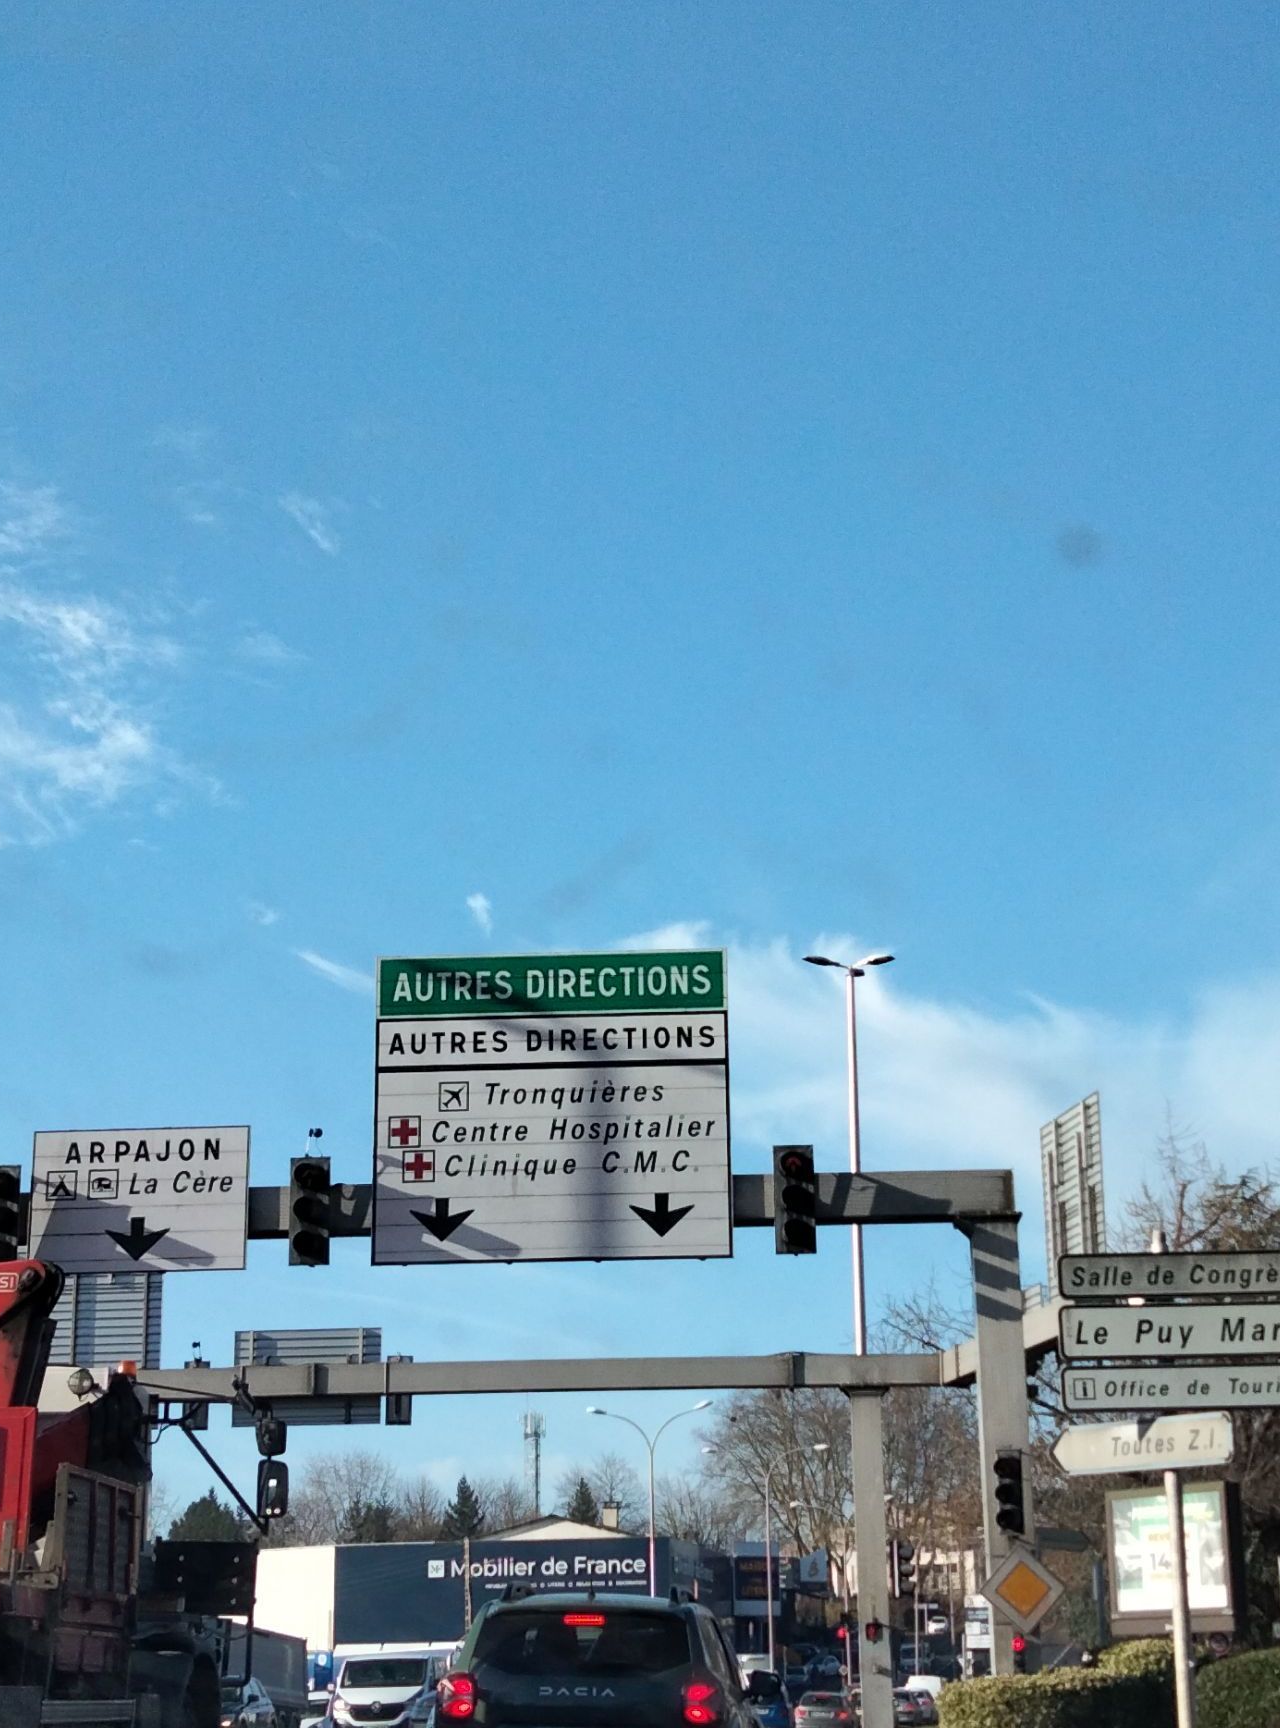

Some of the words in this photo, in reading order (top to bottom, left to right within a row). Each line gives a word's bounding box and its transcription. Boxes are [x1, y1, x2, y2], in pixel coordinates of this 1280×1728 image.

[393, 969, 513, 1002] AUTRES
[526, 964, 712, 1000] DIRECTIONS
[388, 1030, 509, 1055] AUTRES
[525, 1025, 716, 1053] DIRECTIONS
[484, 1080, 665, 1110] Tronquières
[432, 1120, 528, 1143] Centre
[549, 1113, 716, 1145] Hospitalier
[65, 1137, 222, 1165] ARPAJON
[444, 1153, 577, 1182] Clinique
[601, 1149, 701, 1174] C.M.C.
[129, 1172, 157, 1195] La
[172, 1169, 234, 1194] Cère
[1071, 1266, 1133, 1287] Salle
[1146, 1264, 1175, 1286] de
[1075, 1319, 1109, 1345] Le
[1135, 1318, 1194, 1349] Puy
[1104, 1379, 1170, 1398] Office
[1187, 1379, 1211, 1396] de
[1111, 1436, 1176, 1457] Toutes
[450, 1555, 536, 1578] Mobilier
[540, 1555, 569, 1577] de
[574, 1555, 647, 1576] France
[539, 1686, 616, 1697] DACIA
